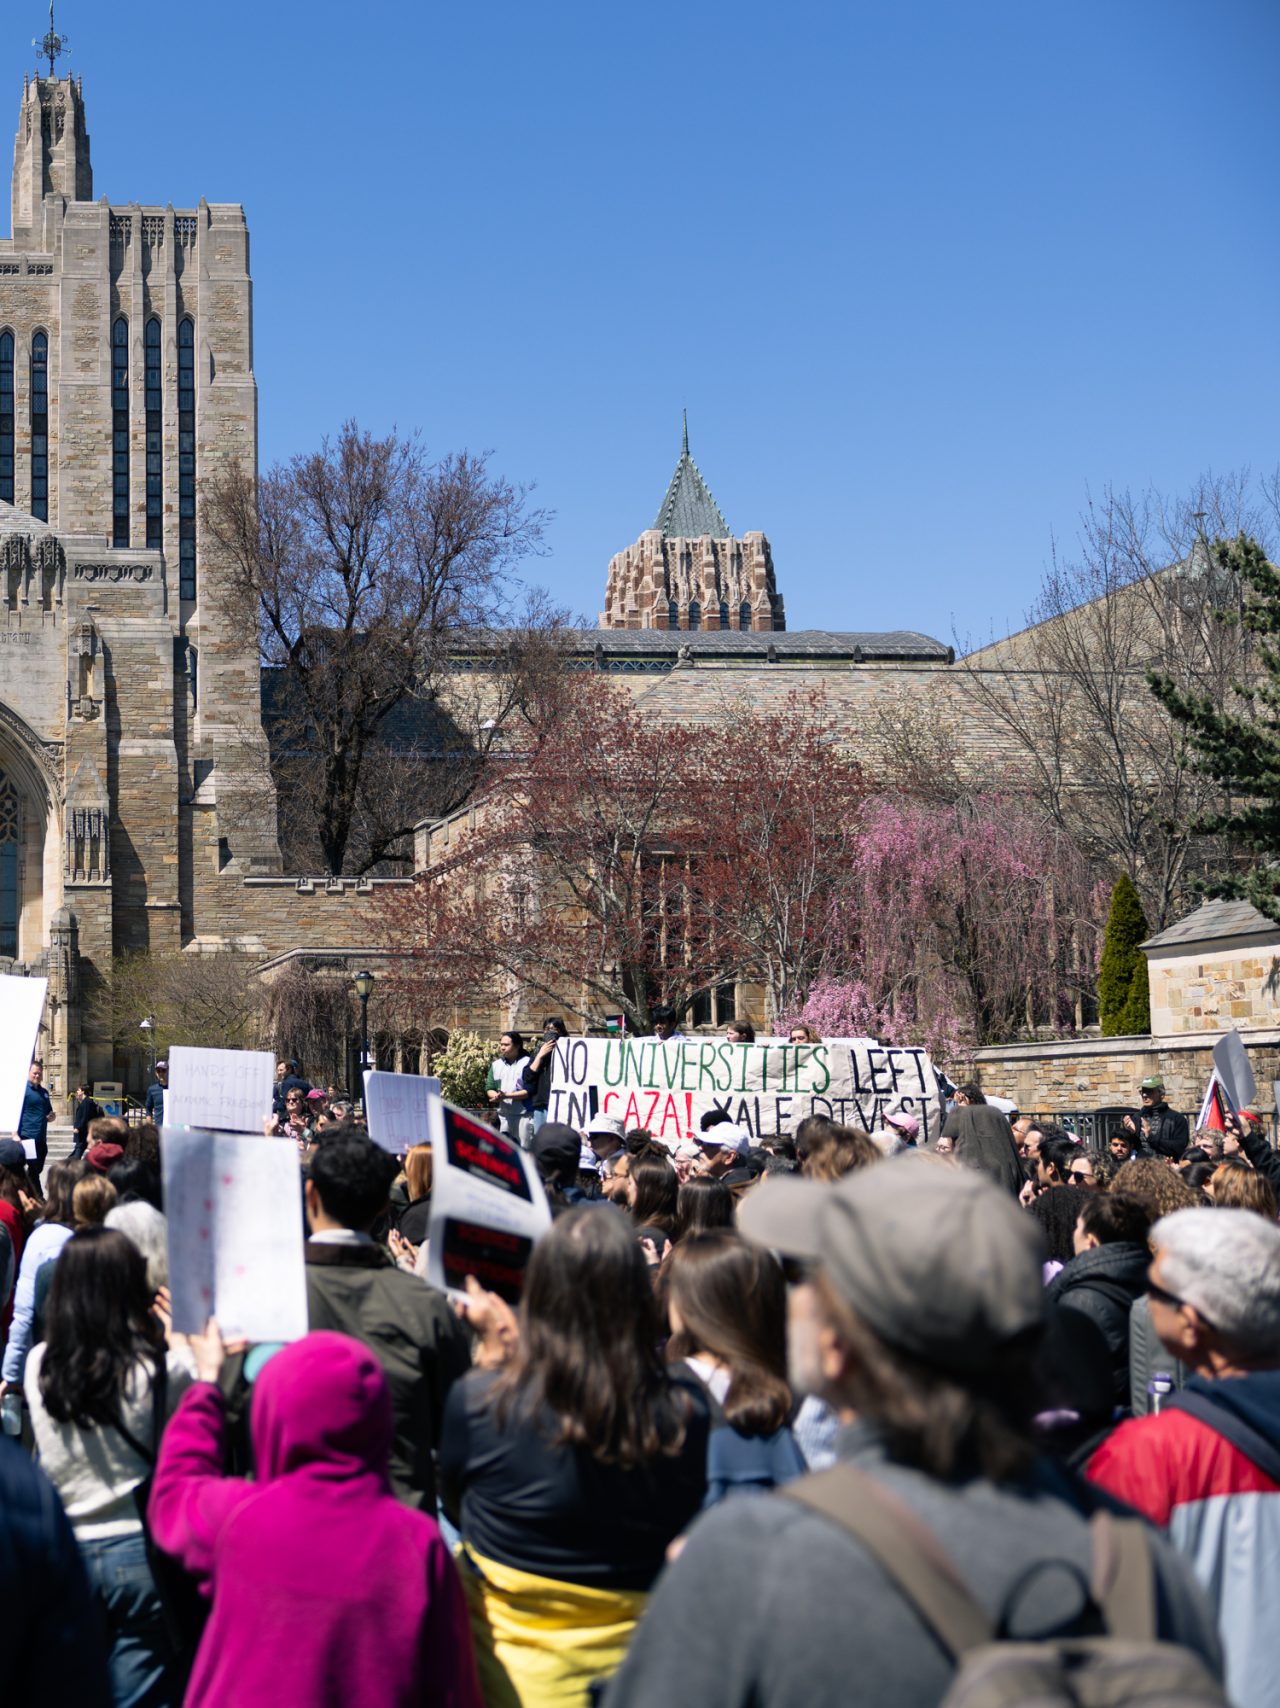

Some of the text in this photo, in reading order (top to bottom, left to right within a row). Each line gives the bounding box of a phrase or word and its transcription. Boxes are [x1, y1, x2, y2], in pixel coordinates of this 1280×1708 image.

[551, 1038, 927, 1094] NO UNIVERSITIES LEFT
[551, 1089, 587, 1131] IN
[713, 1096, 792, 1139] YALE
